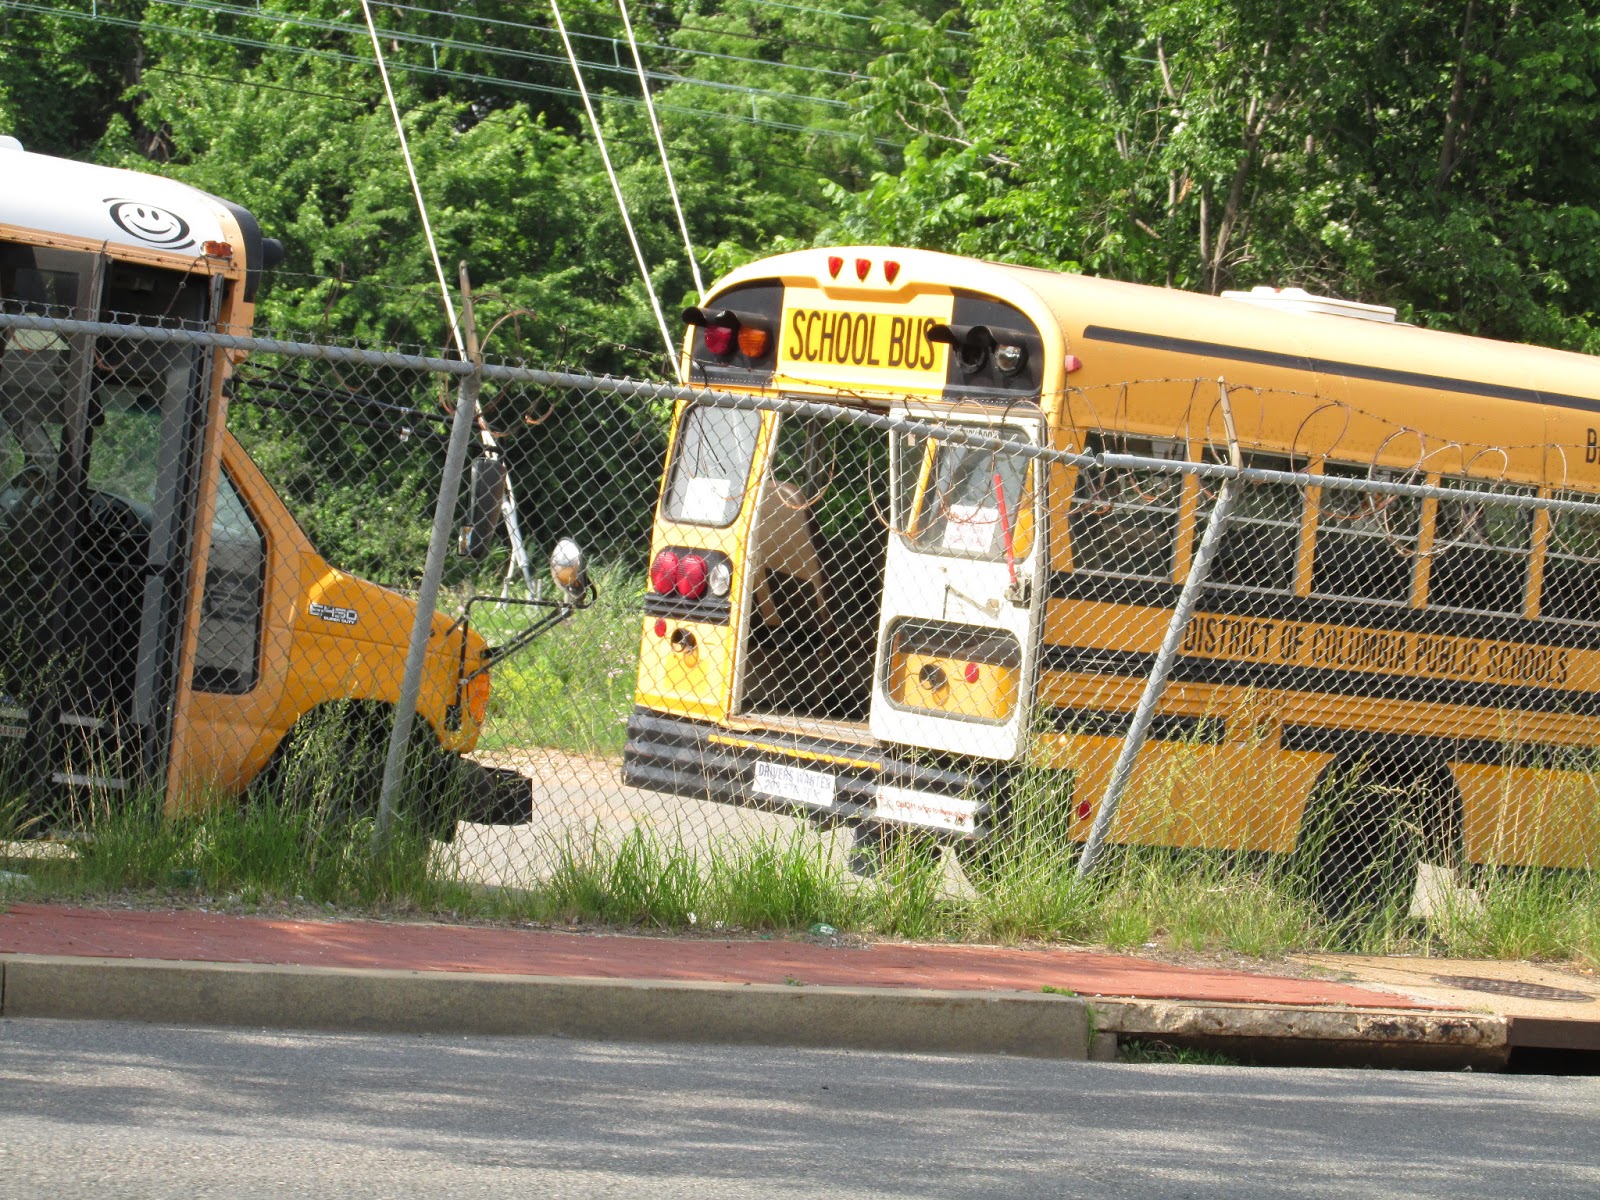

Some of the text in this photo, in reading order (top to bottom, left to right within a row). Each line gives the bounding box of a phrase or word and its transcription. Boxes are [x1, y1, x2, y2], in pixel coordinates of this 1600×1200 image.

[790, 309, 937, 371] SCHOOL BUS
[1184, 617, 1568, 684] DISTRICT OF COLUMBIA PUBLIC SCHOOLS
